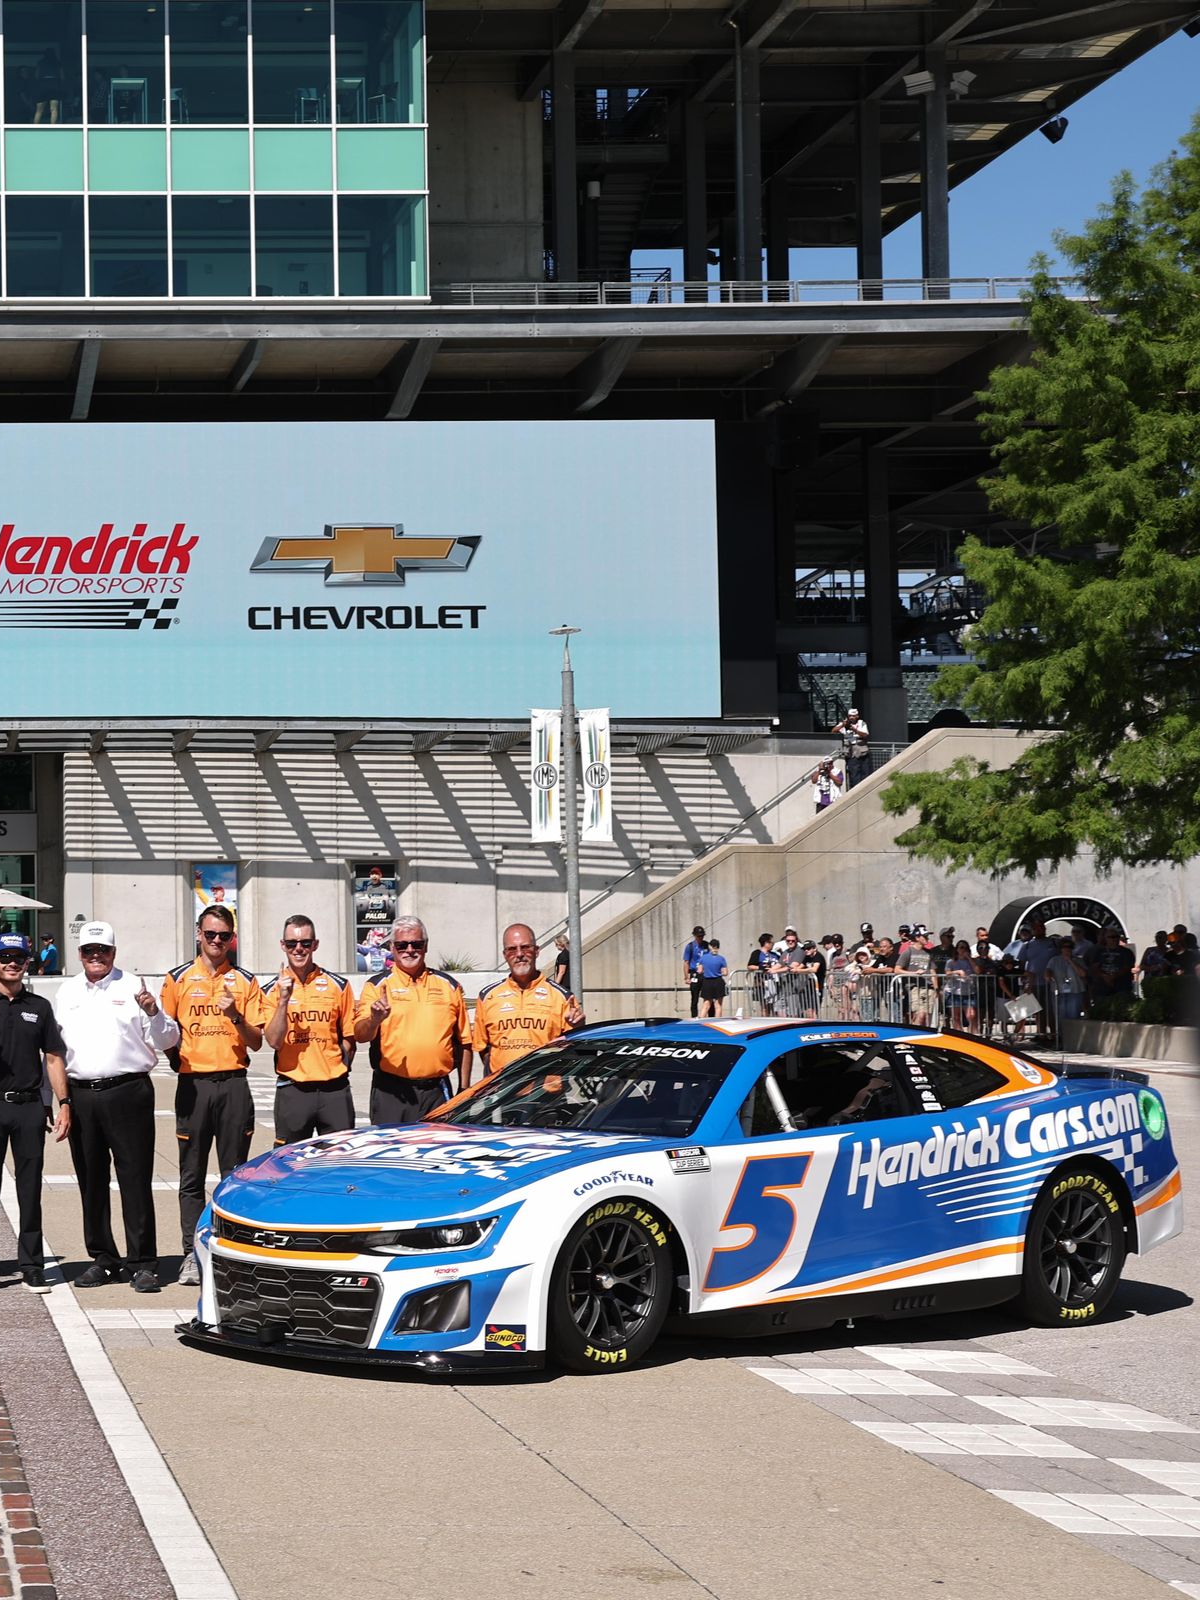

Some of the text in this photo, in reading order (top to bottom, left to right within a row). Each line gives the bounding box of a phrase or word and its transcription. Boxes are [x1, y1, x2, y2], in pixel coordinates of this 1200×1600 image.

[0, 577, 185, 595] MOTORSPORTS
[247, 604, 487, 630] CHEVROLET
[615, 1045, 711, 1060] LARSON
[702, 1151, 815, 1292] 5
[330, 1276, 369, 1287] ZL1
[1059, 1302, 1096, 1320] EAGLE
[487, 1334, 524, 1342] SUNOCO
[584, 1344, 627, 1363] EAGLE
